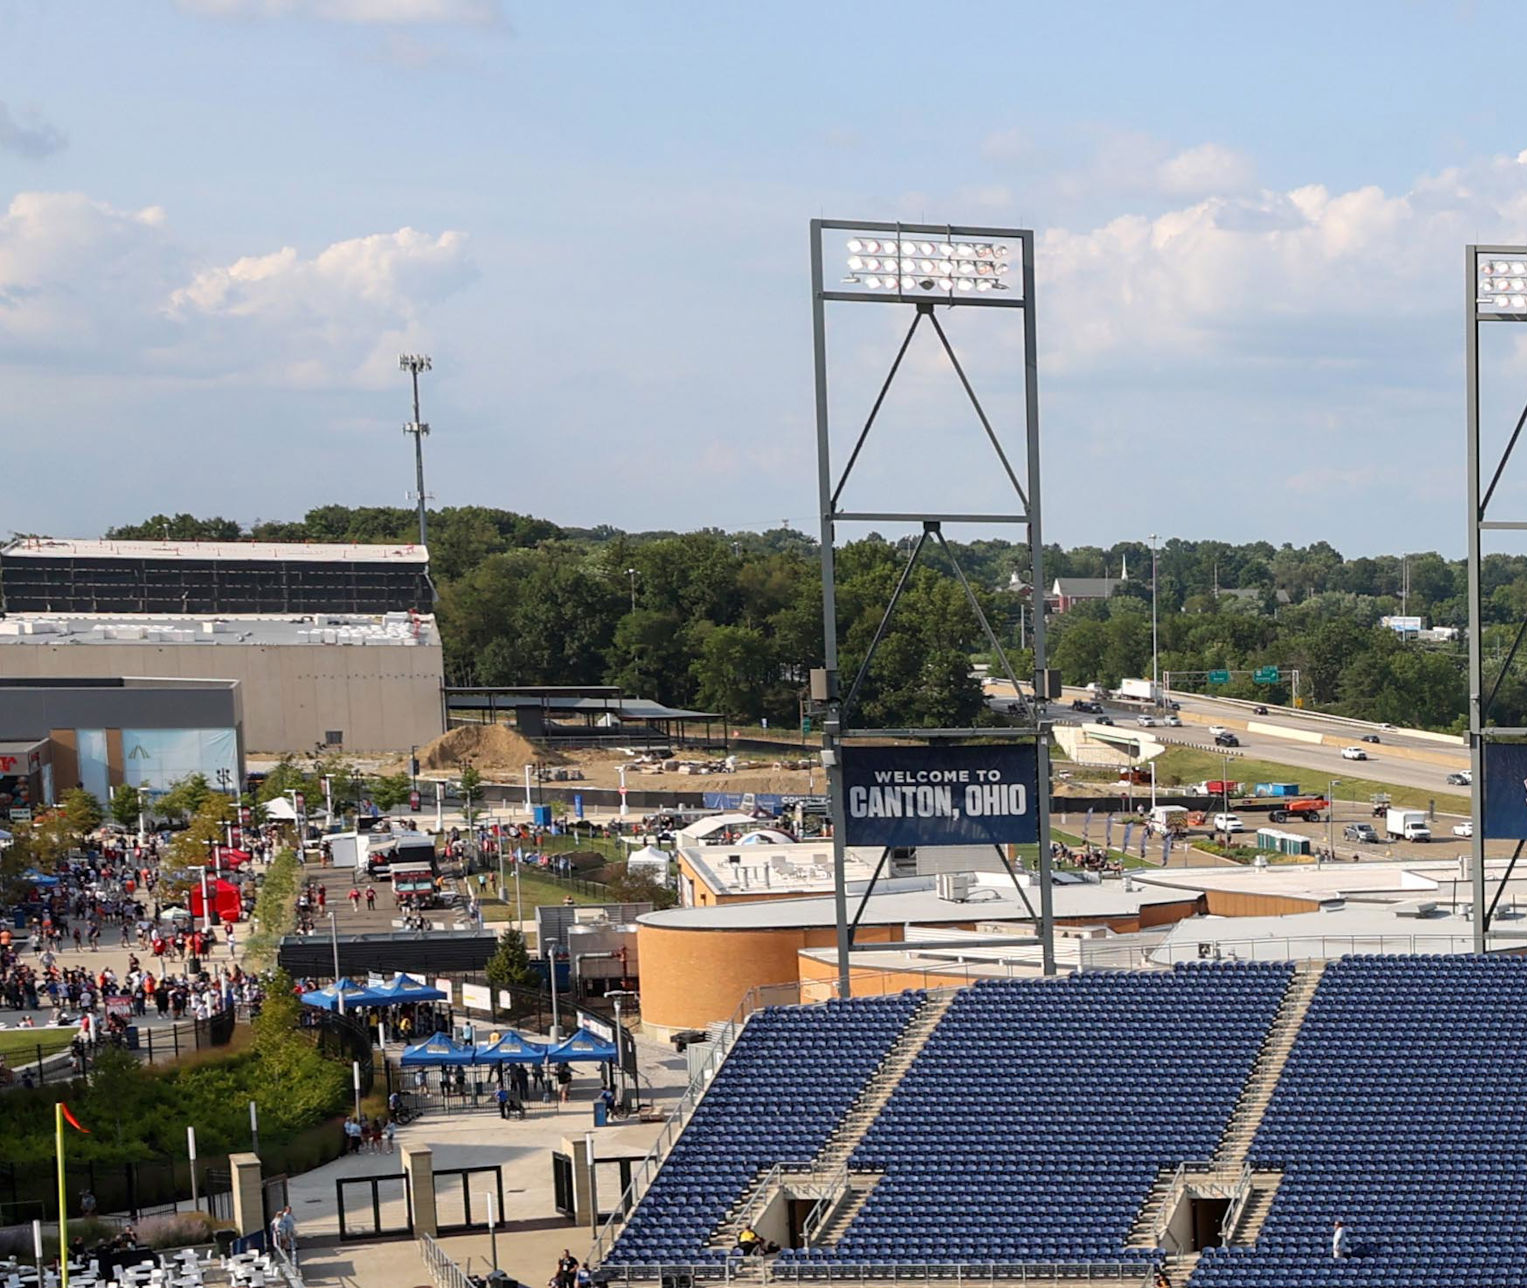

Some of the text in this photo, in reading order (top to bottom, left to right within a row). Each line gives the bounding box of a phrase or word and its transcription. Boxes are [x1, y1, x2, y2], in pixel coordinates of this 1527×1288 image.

[874, 769, 1001, 783] WELCOME TO
[849, 784, 1027, 821] CANTON, OHIO
